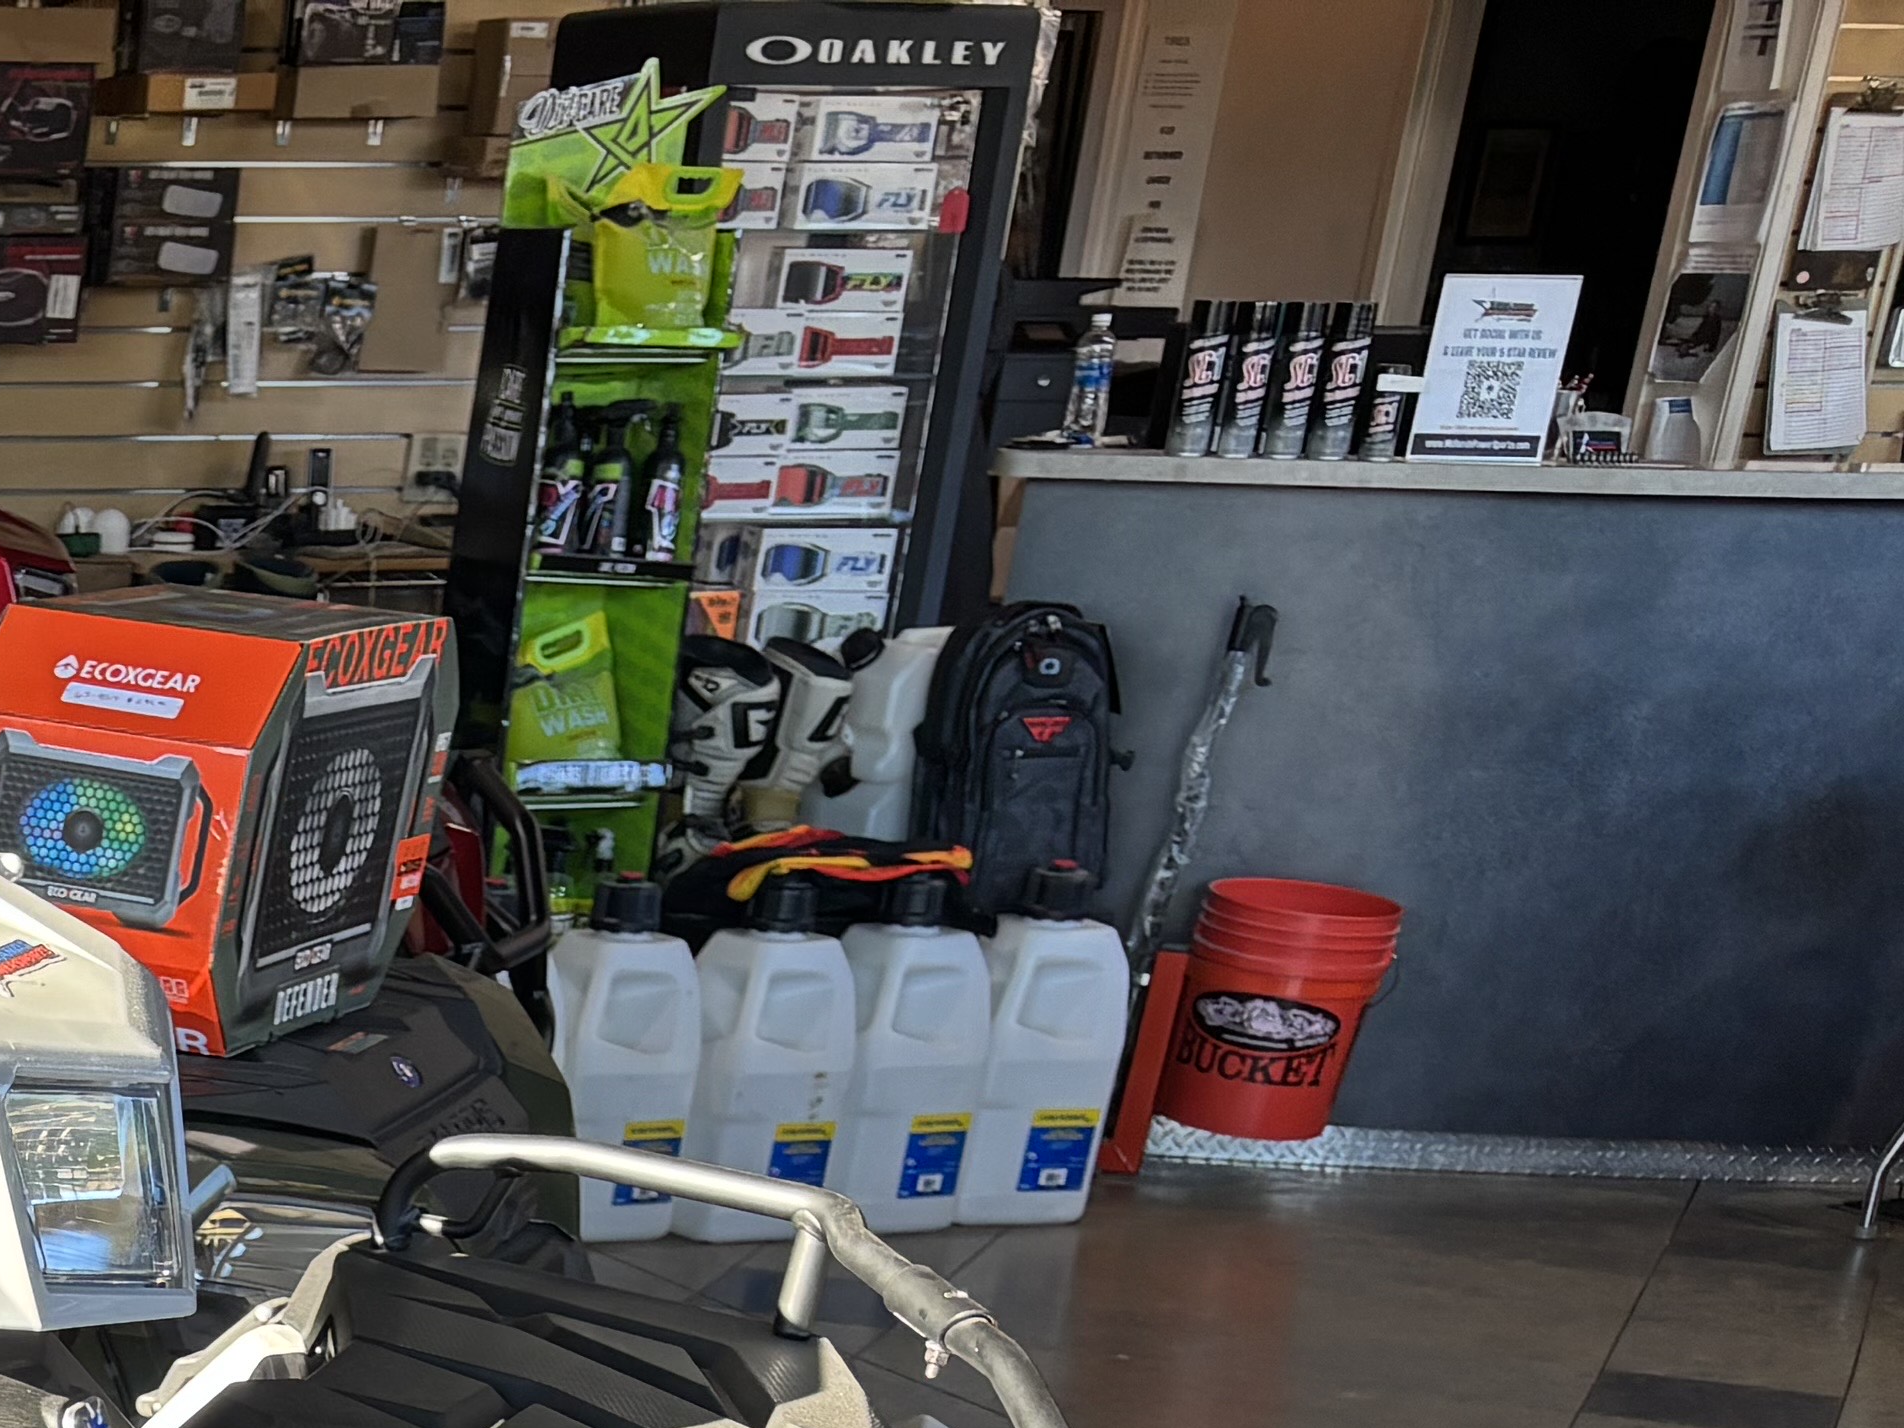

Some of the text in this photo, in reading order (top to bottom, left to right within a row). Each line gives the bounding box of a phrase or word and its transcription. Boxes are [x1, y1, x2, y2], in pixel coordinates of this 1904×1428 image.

[816, 38, 1008, 66] OAKLEY
[79, 659, 202, 694] ECOXGEAR
[305, 618, 448, 690] ECOXGEAR
[273, 971, 340, 1026] DEFENDER
[1176, 1032, 1338, 1088] BUCKET
